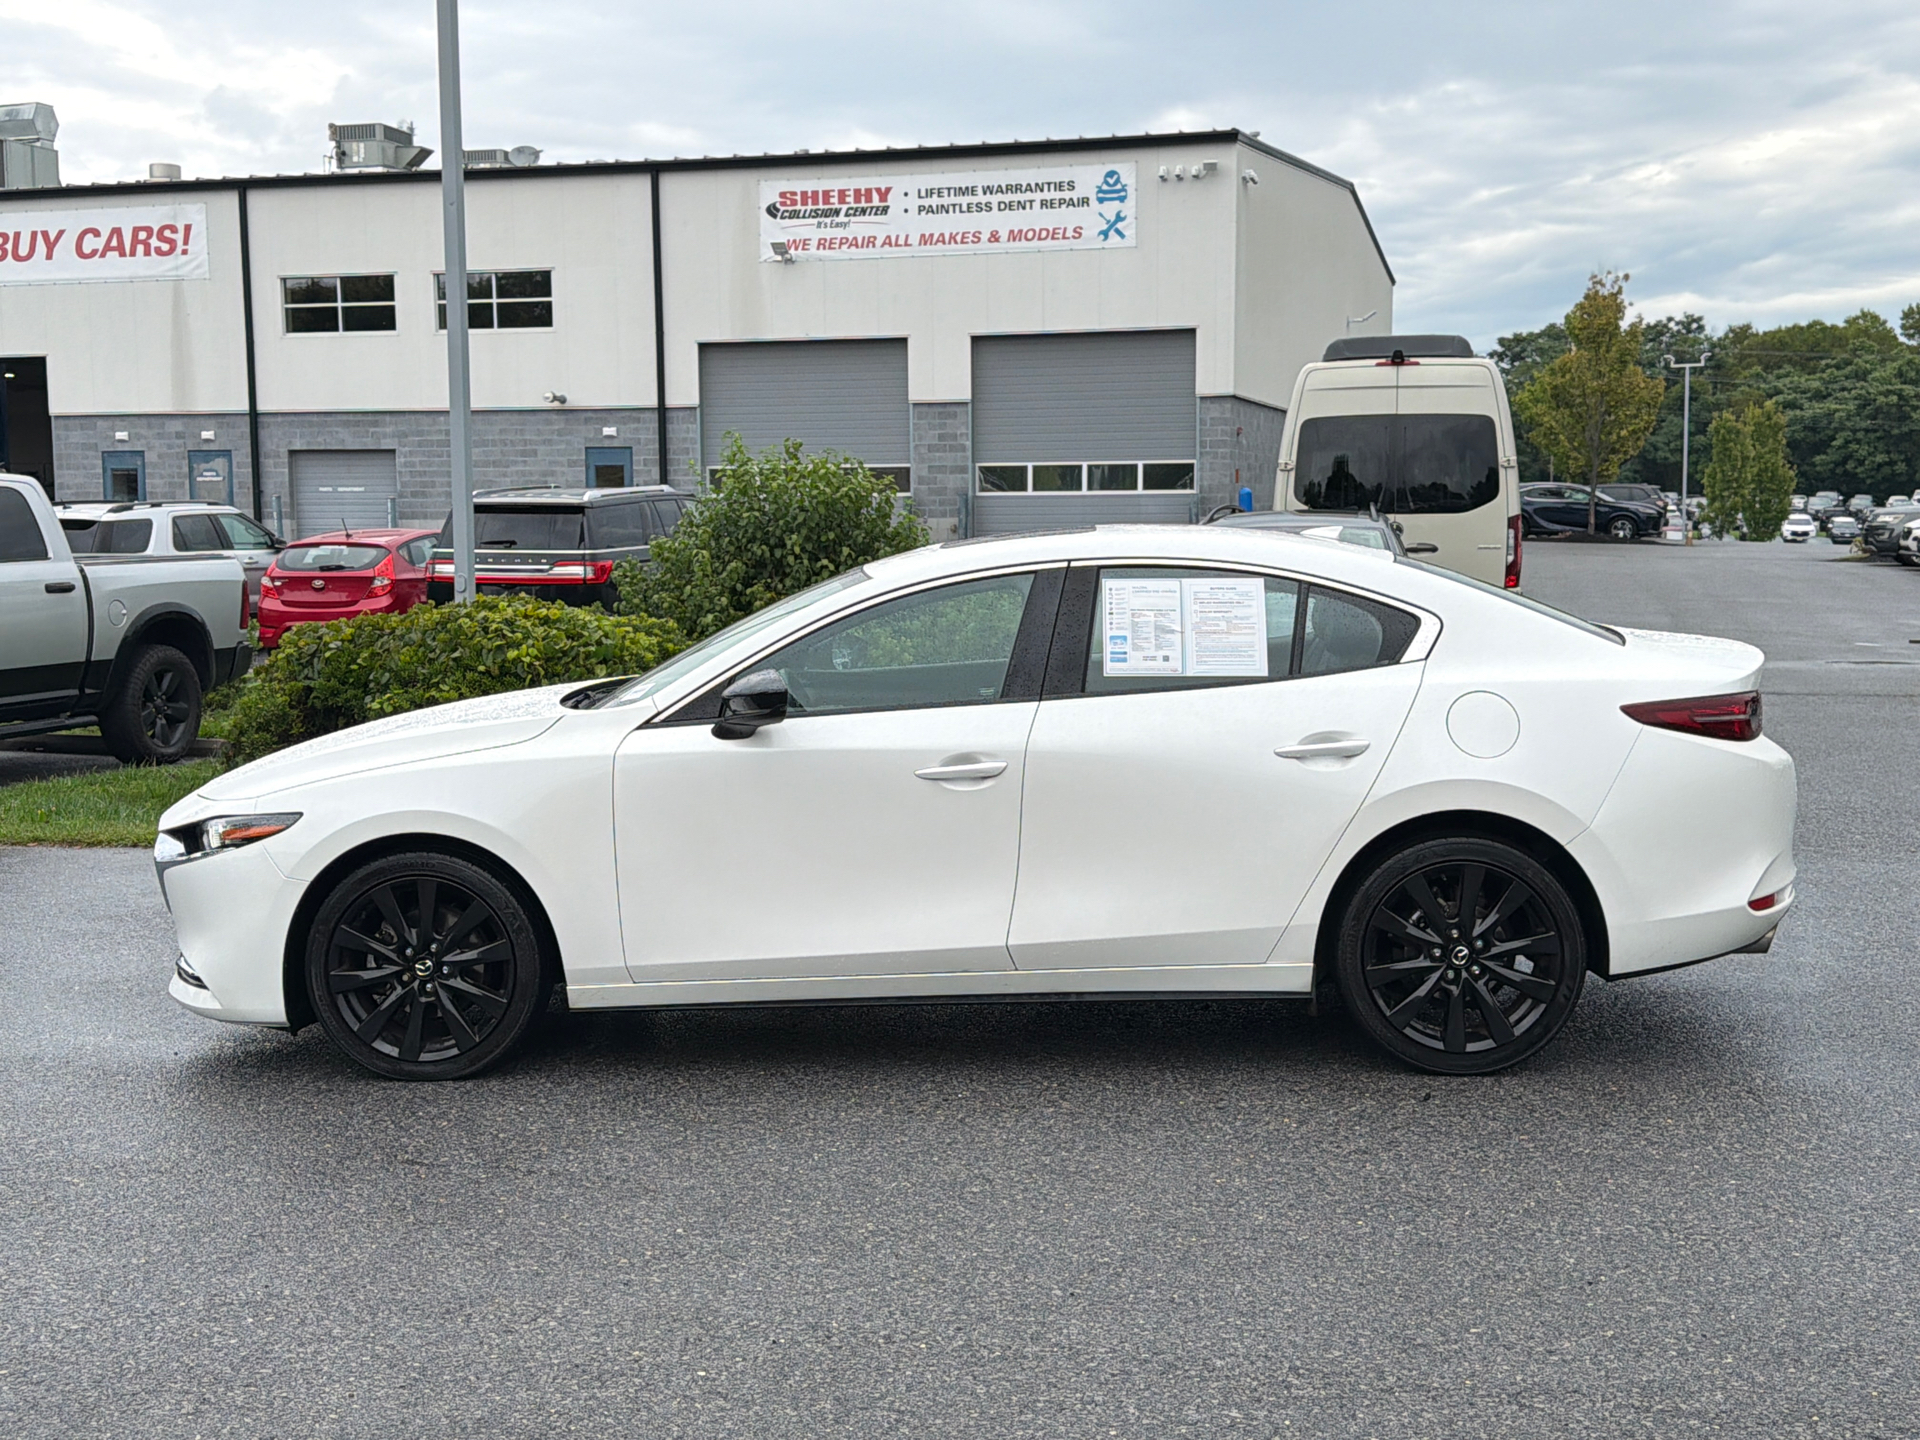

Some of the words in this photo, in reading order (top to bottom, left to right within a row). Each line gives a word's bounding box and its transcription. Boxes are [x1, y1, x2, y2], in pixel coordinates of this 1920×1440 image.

[778, 186, 893, 207] SHEEHY
[917, 185, 978, 199] LIFETIME
[982, 180, 1076, 196] WARRANTIES
[779, 207, 842, 220] COLLISION
[844, 205, 890, 217] CENTER
[917, 201, 993, 215] PAINTLESS
[997, 199, 1036, 212] DENT
[1040, 196, 1090, 210] REPAIR
[816, 220, 828, 229] It's
[829, 219, 851, 230] Easy!
[75, 223, 193, 260] CARS!
[786, 238, 812, 251] WE
[816, 235, 878, 251] REPAIR
[880, 233, 913, 248] ALL
[918, 230, 982, 246] MAKES
[987, 229, 1001, 243] &
[1007, 226, 1083, 243] MODELS
